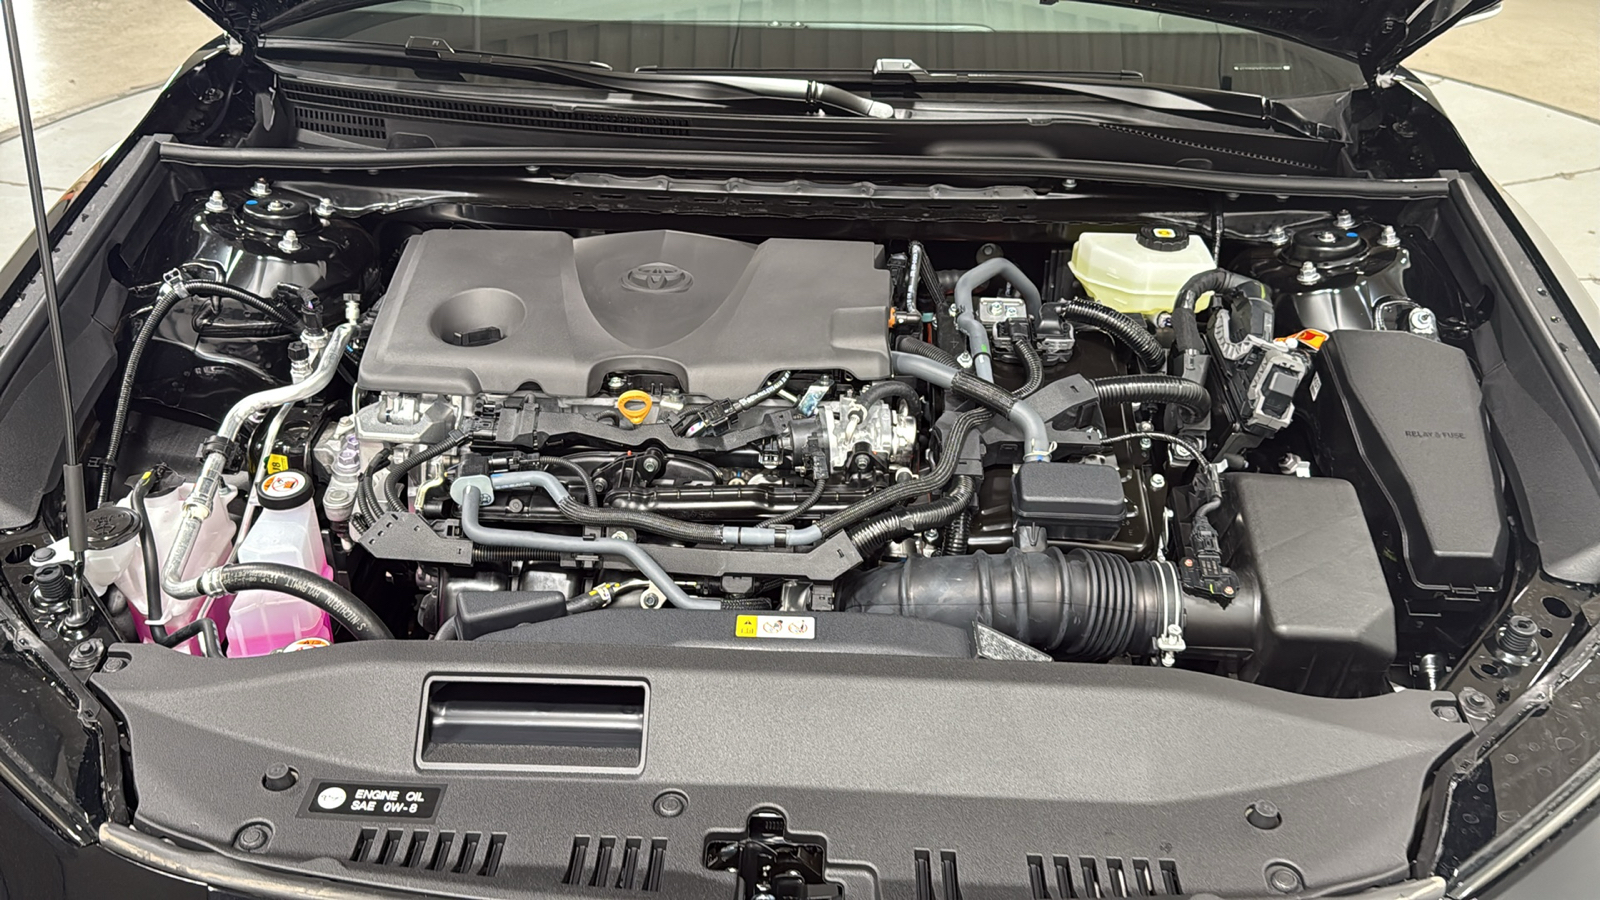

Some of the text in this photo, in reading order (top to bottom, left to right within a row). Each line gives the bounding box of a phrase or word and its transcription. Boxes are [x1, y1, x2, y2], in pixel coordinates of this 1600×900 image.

[1405, 430, 1466, 440] RELAY & FUSE
[355, 789, 424, 801] ENGINE OIL
[350, 800, 418, 813] SAE 0W-8
